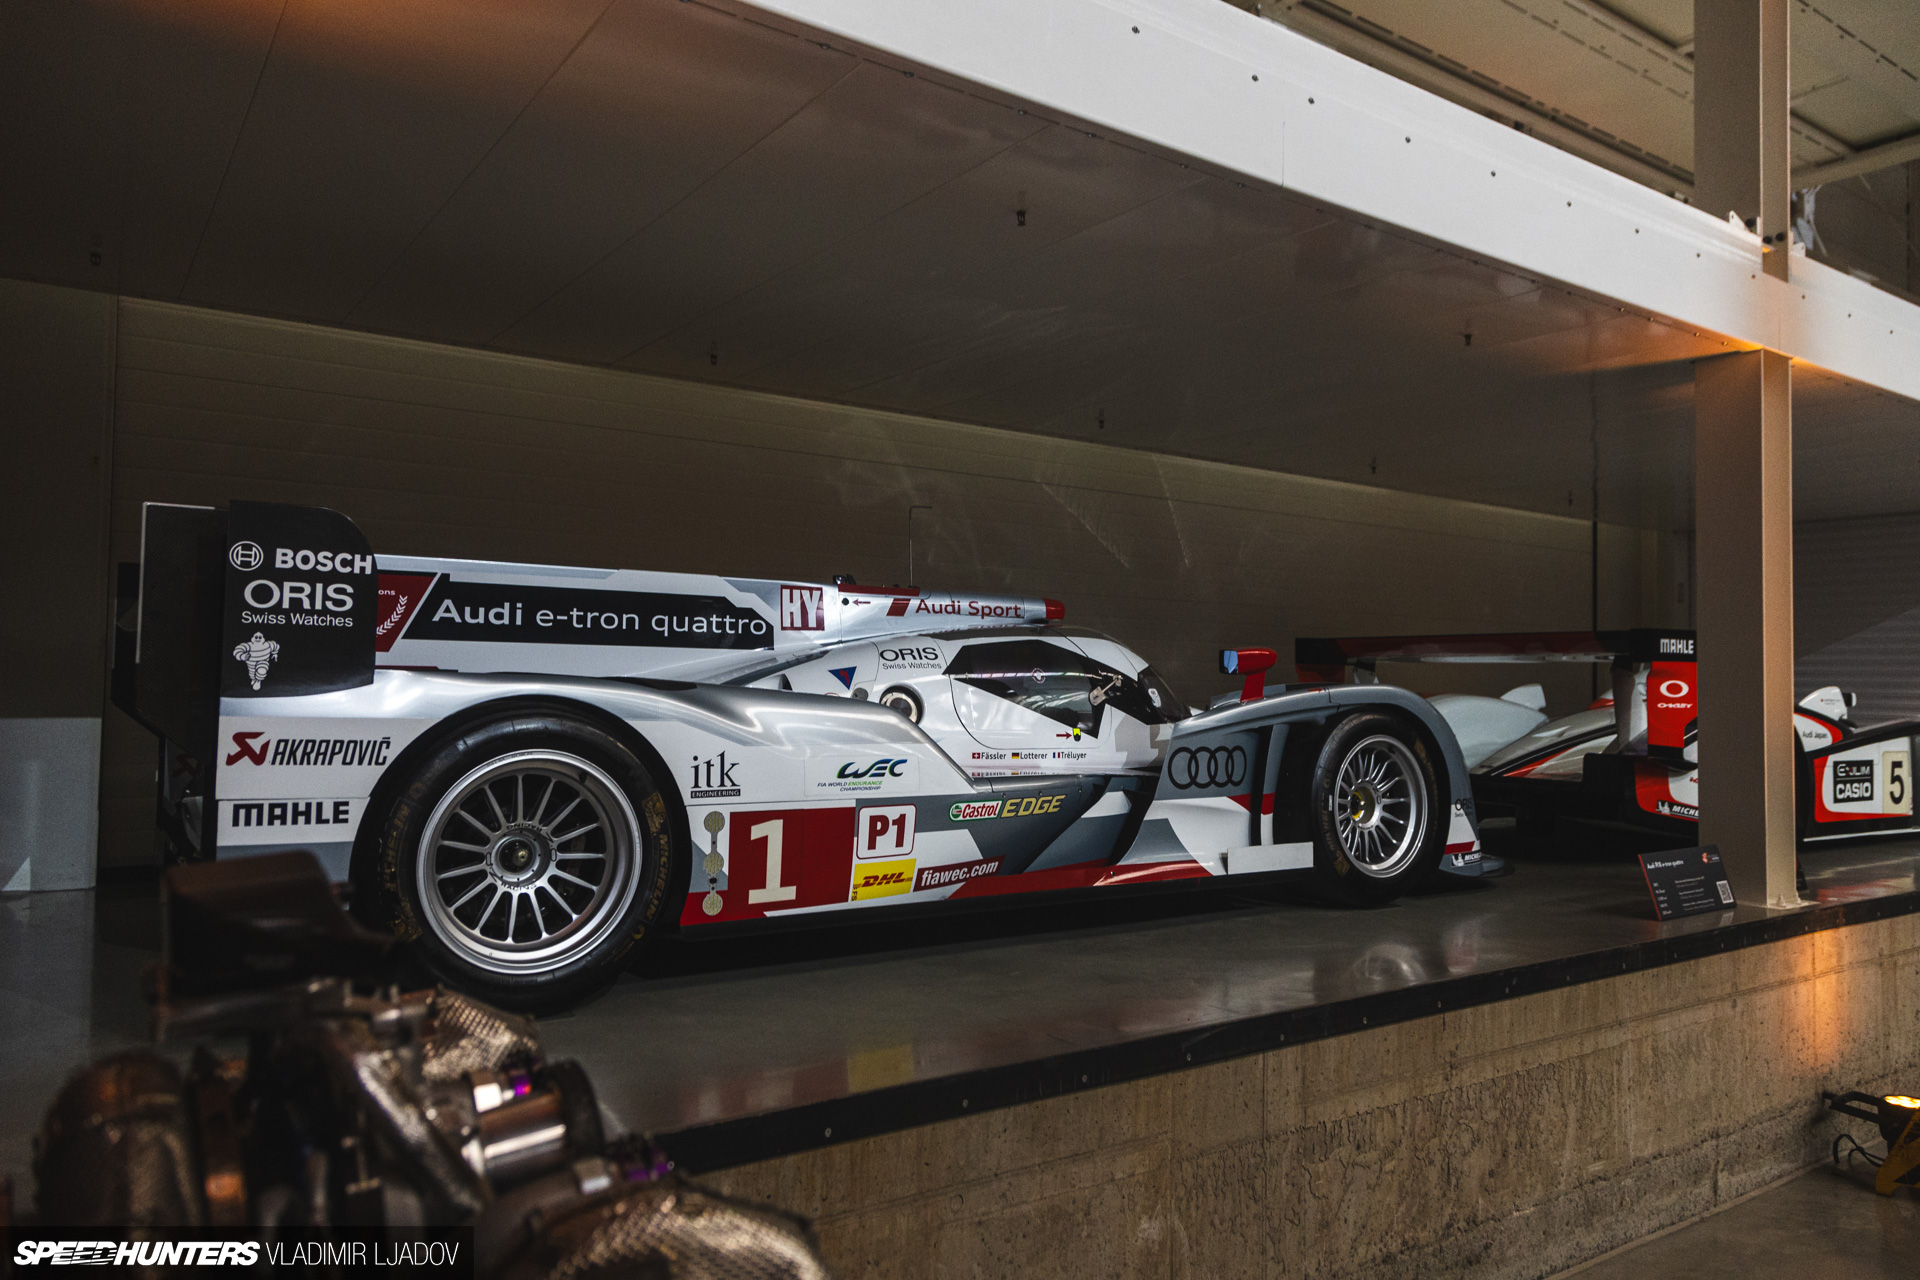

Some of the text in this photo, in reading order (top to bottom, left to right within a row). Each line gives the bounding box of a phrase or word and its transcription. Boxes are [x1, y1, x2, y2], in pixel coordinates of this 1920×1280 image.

[275, 548, 372, 575] BOSCH
[244, 579, 354, 612] ORIS
[241, 611, 354, 627] Swiss Watches
[432, 599, 768, 637] Audi e-tron quattro
[781, 588, 822, 629] HY
[915, 599, 1022, 620] Audi Sport
[879, 647, 939, 662] ORIS
[1660, 638, 1694, 655] MAHLE
[882, 661, 942, 670] Swiss Watches
[981, 752, 1007, 760] Fässler
[1020, 752, 1048, 760] Lotterer
[1061, 752, 1087, 760] Tréluyer
[690, 750, 740, 788] itk
[837, 758, 908, 779] WEC
[1836, 782, 1871, 799] CASIO
[1889, 760, 1905, 805] 5
[692, 789, 740, 798] ENGINEERING
[1455, 797, 1473, 811] ORIS
[232, 801, 350, 828] MAHLE
[961, 802, 1000, 819] Castrol
[1001, 794, 1066, 818] EDGE
[867, 813, 907, 851] P1
[748, 818, 797, 905] 1
[646, 834, 669, 921] MICHELIN
[861, 872, 904, 888] DHL
[921, 861, 999, 887] fiawec.com
